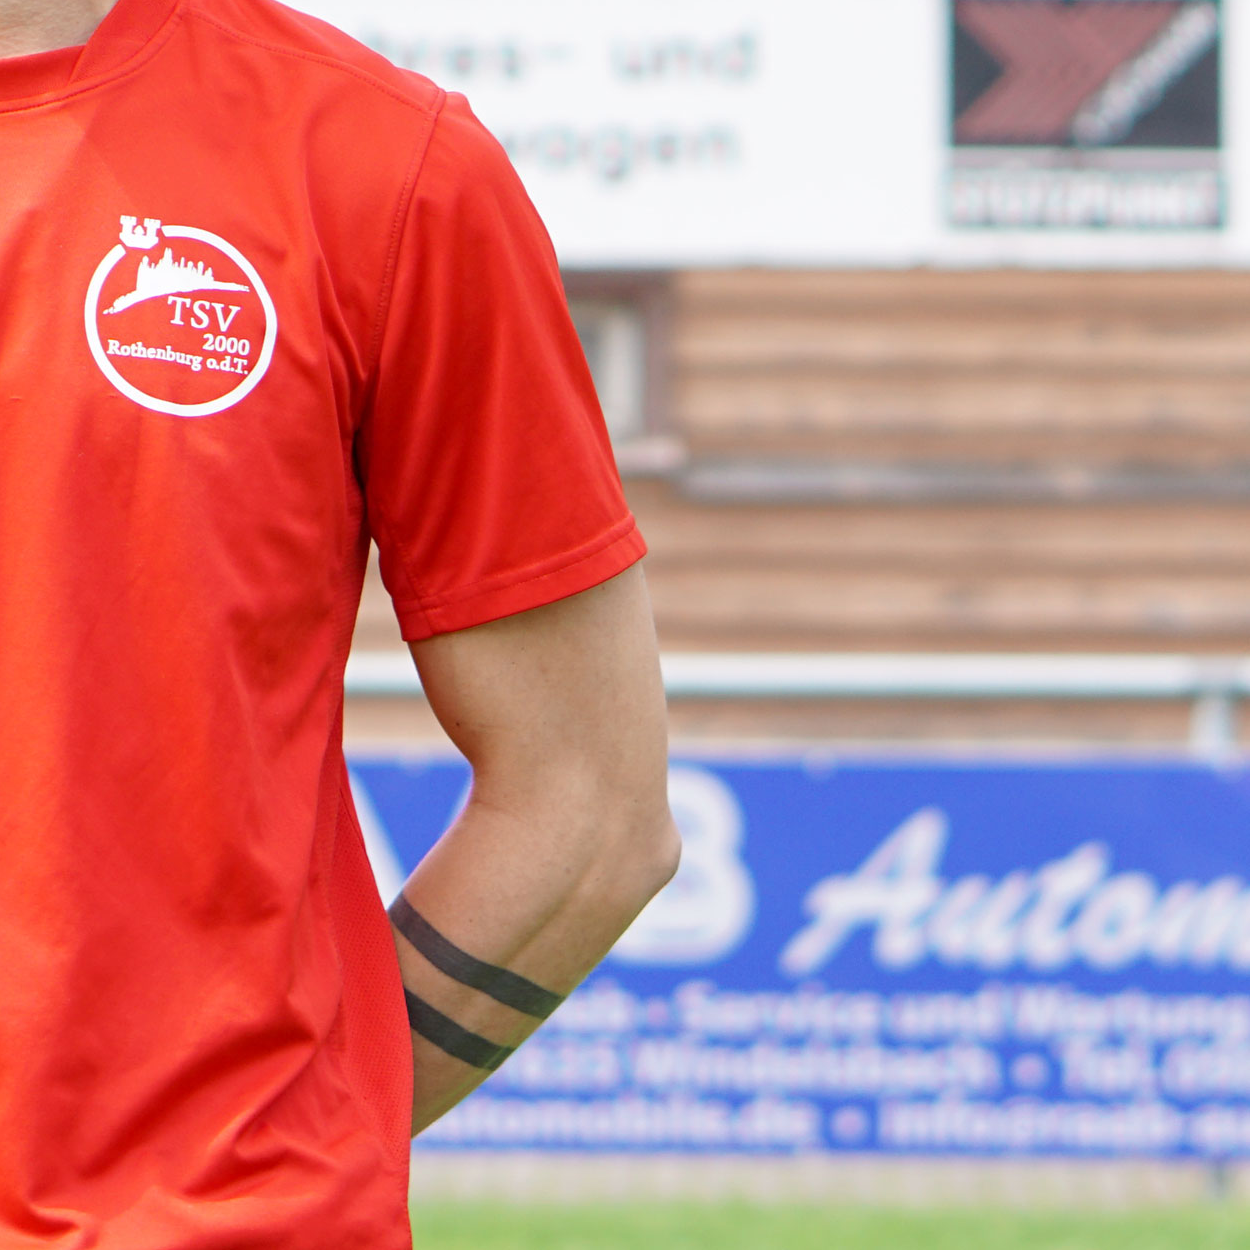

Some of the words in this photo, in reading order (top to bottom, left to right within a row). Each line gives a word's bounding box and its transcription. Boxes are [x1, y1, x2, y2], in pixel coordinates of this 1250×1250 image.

[167, 295, 241, 332] TSV
[106, 338, 203, 371] Rothenburg
[206, 355, 249, 375] o.d.T.
[202, 333, 250, 355] 2000
